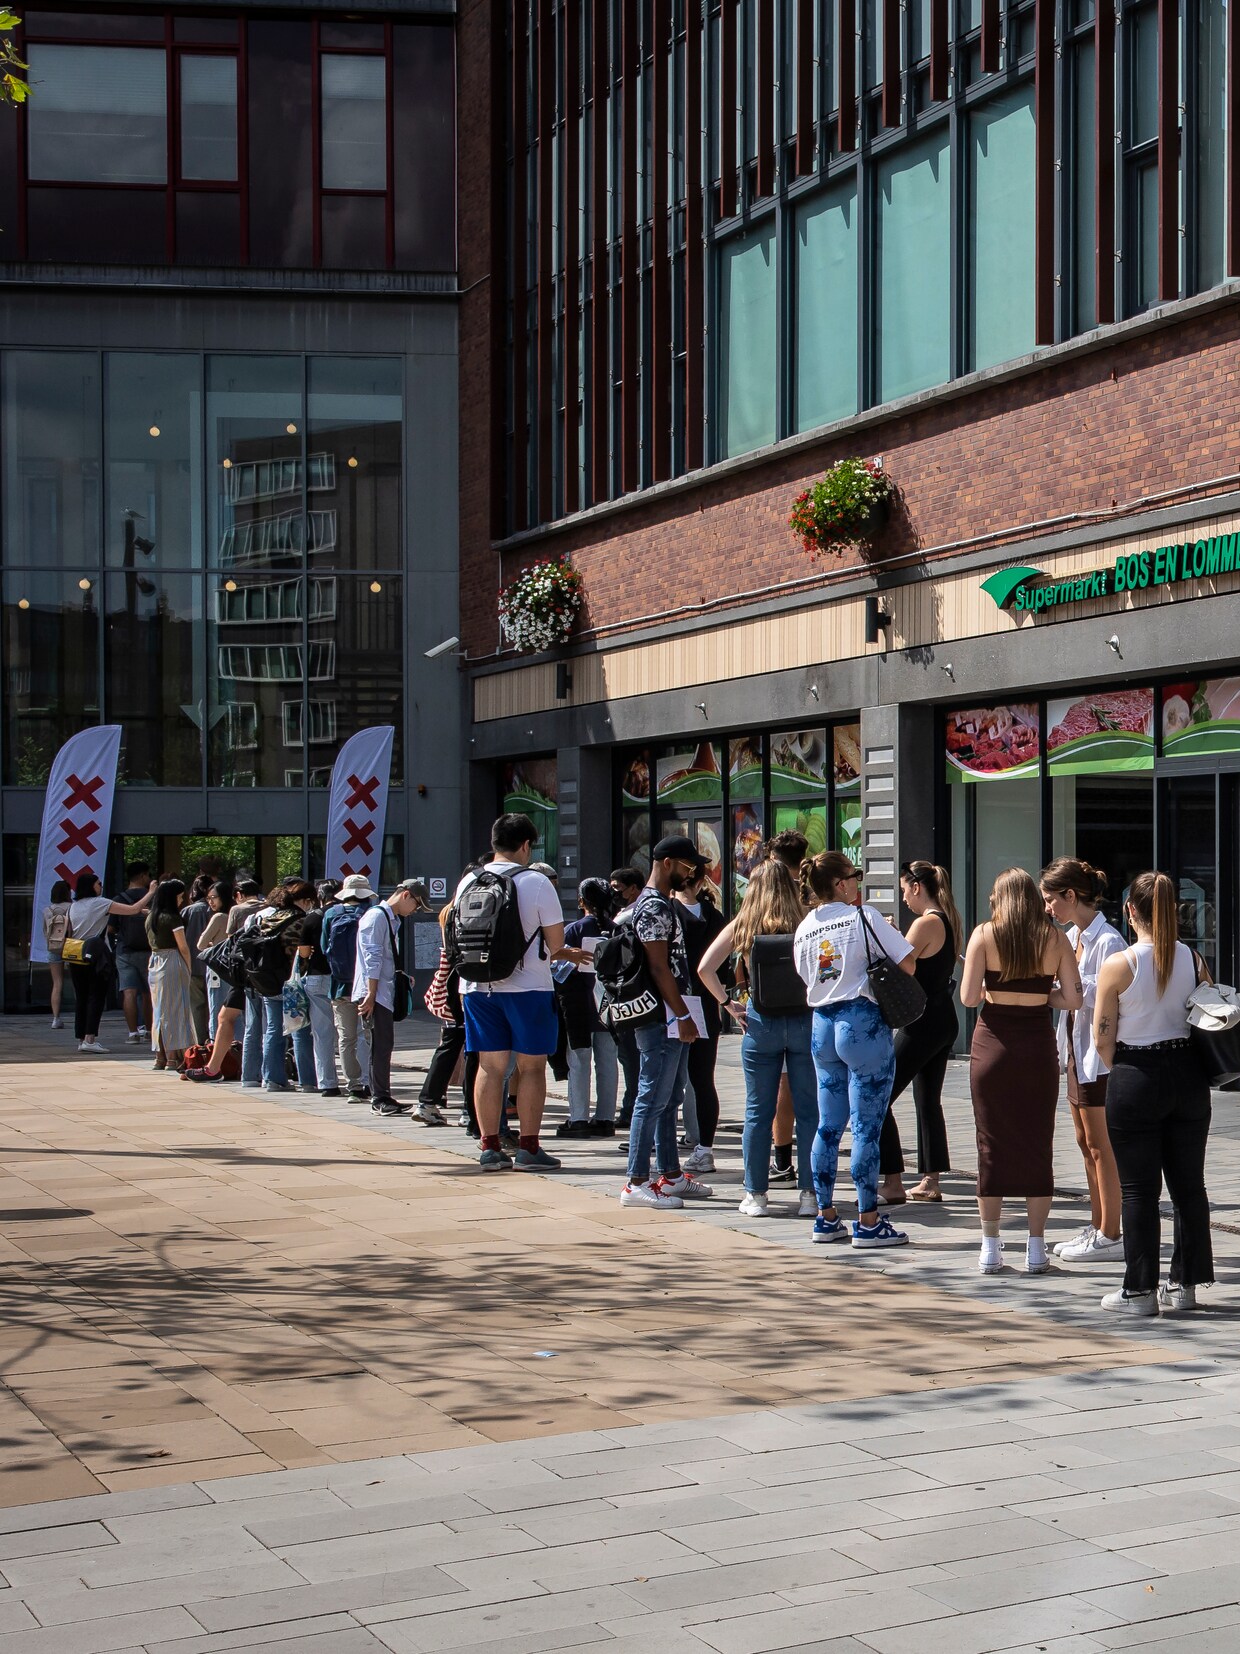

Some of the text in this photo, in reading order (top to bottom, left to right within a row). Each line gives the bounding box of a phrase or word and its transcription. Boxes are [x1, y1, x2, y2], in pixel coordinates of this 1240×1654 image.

[1014, 569, 1108, 613] Supermarkt
[1114, 551, 1151, 592] BOS
[1153, 544, 1179, 585] EN
